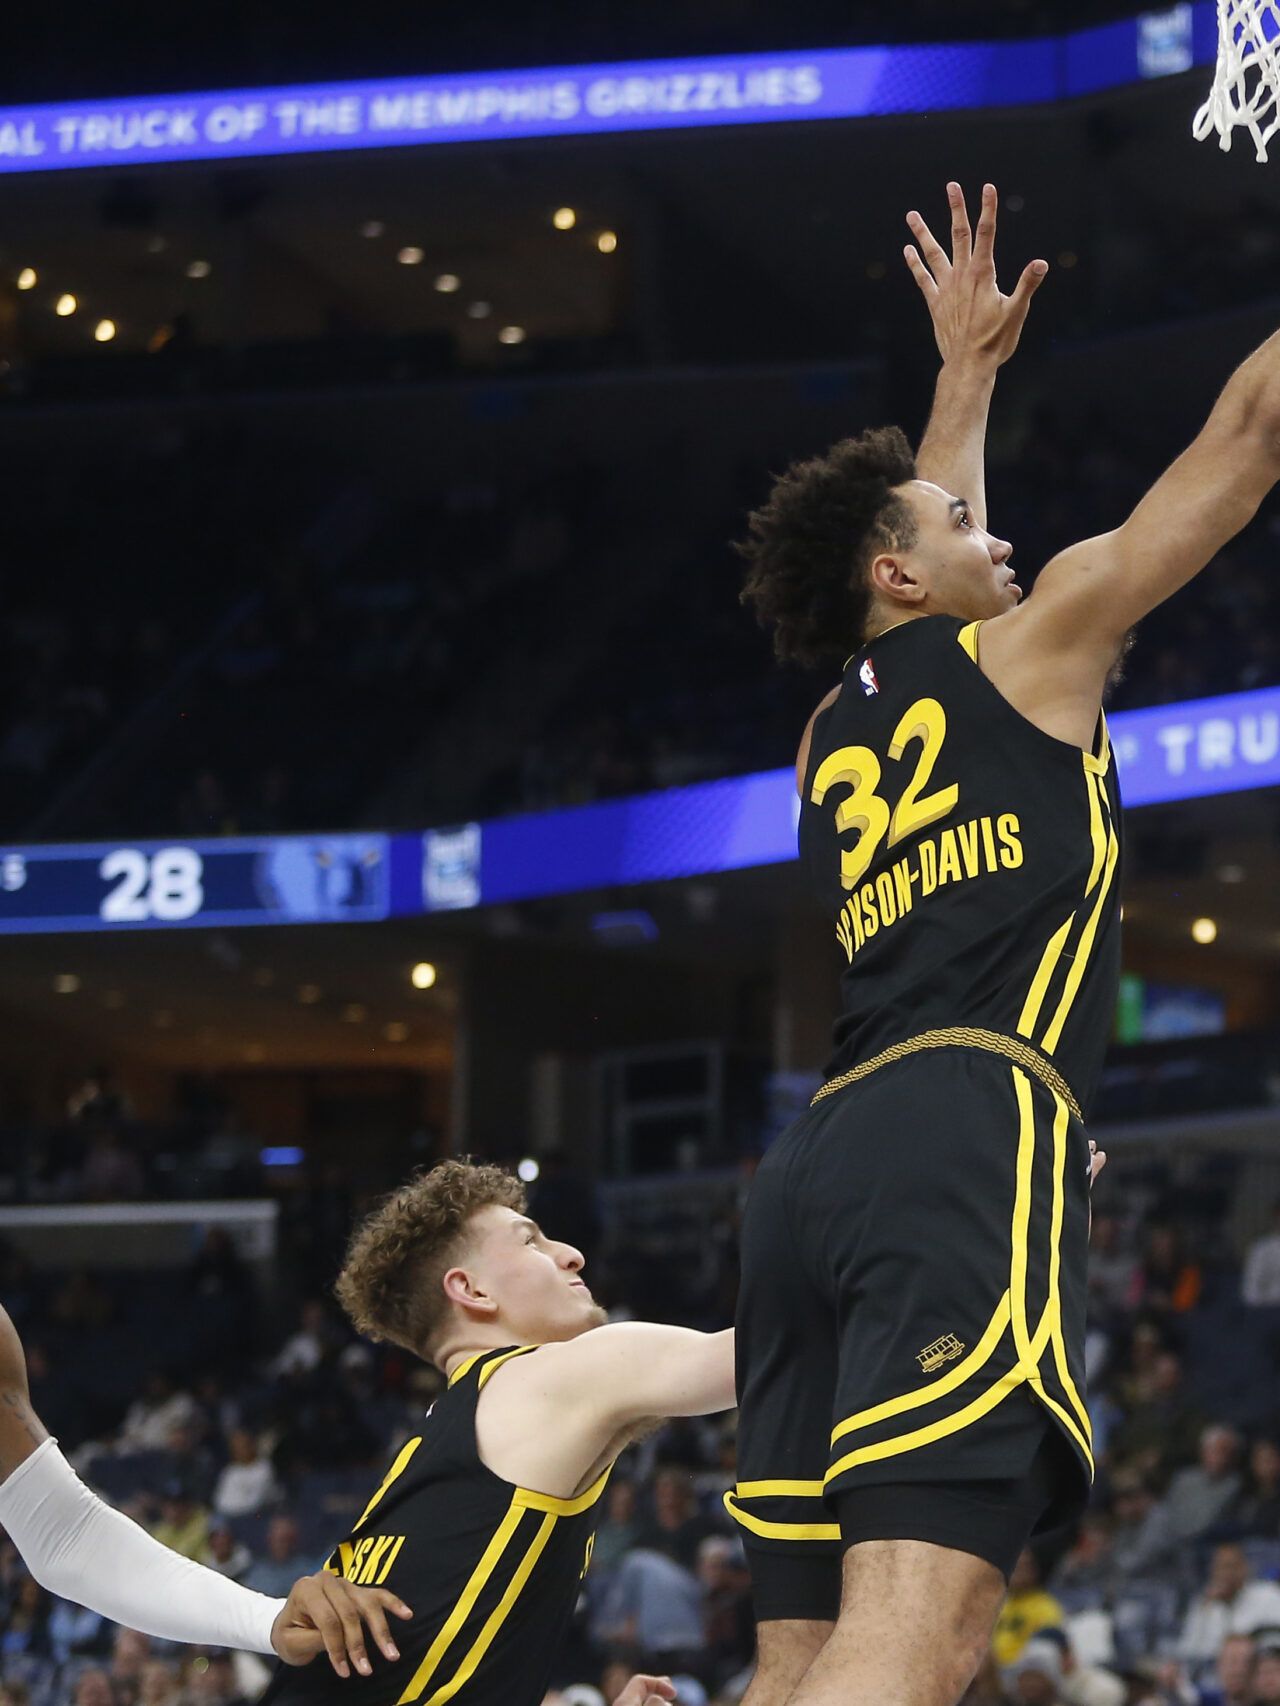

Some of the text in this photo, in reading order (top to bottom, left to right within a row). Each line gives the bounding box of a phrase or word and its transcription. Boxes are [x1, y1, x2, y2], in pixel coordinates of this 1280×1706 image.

[54, 108, 198, 153] TRUCK
[204, 102, 267, 143] OF
[272, 95, 361, 138] THE
[368, 79, 580, 131] MEMPHIS
[585, 65, 822, 118] GRIZZLIES
[811, 697, 959, 891] 32
[100, 847, 204, 922] 28
[344, 1535, 406, 1585] SKI
